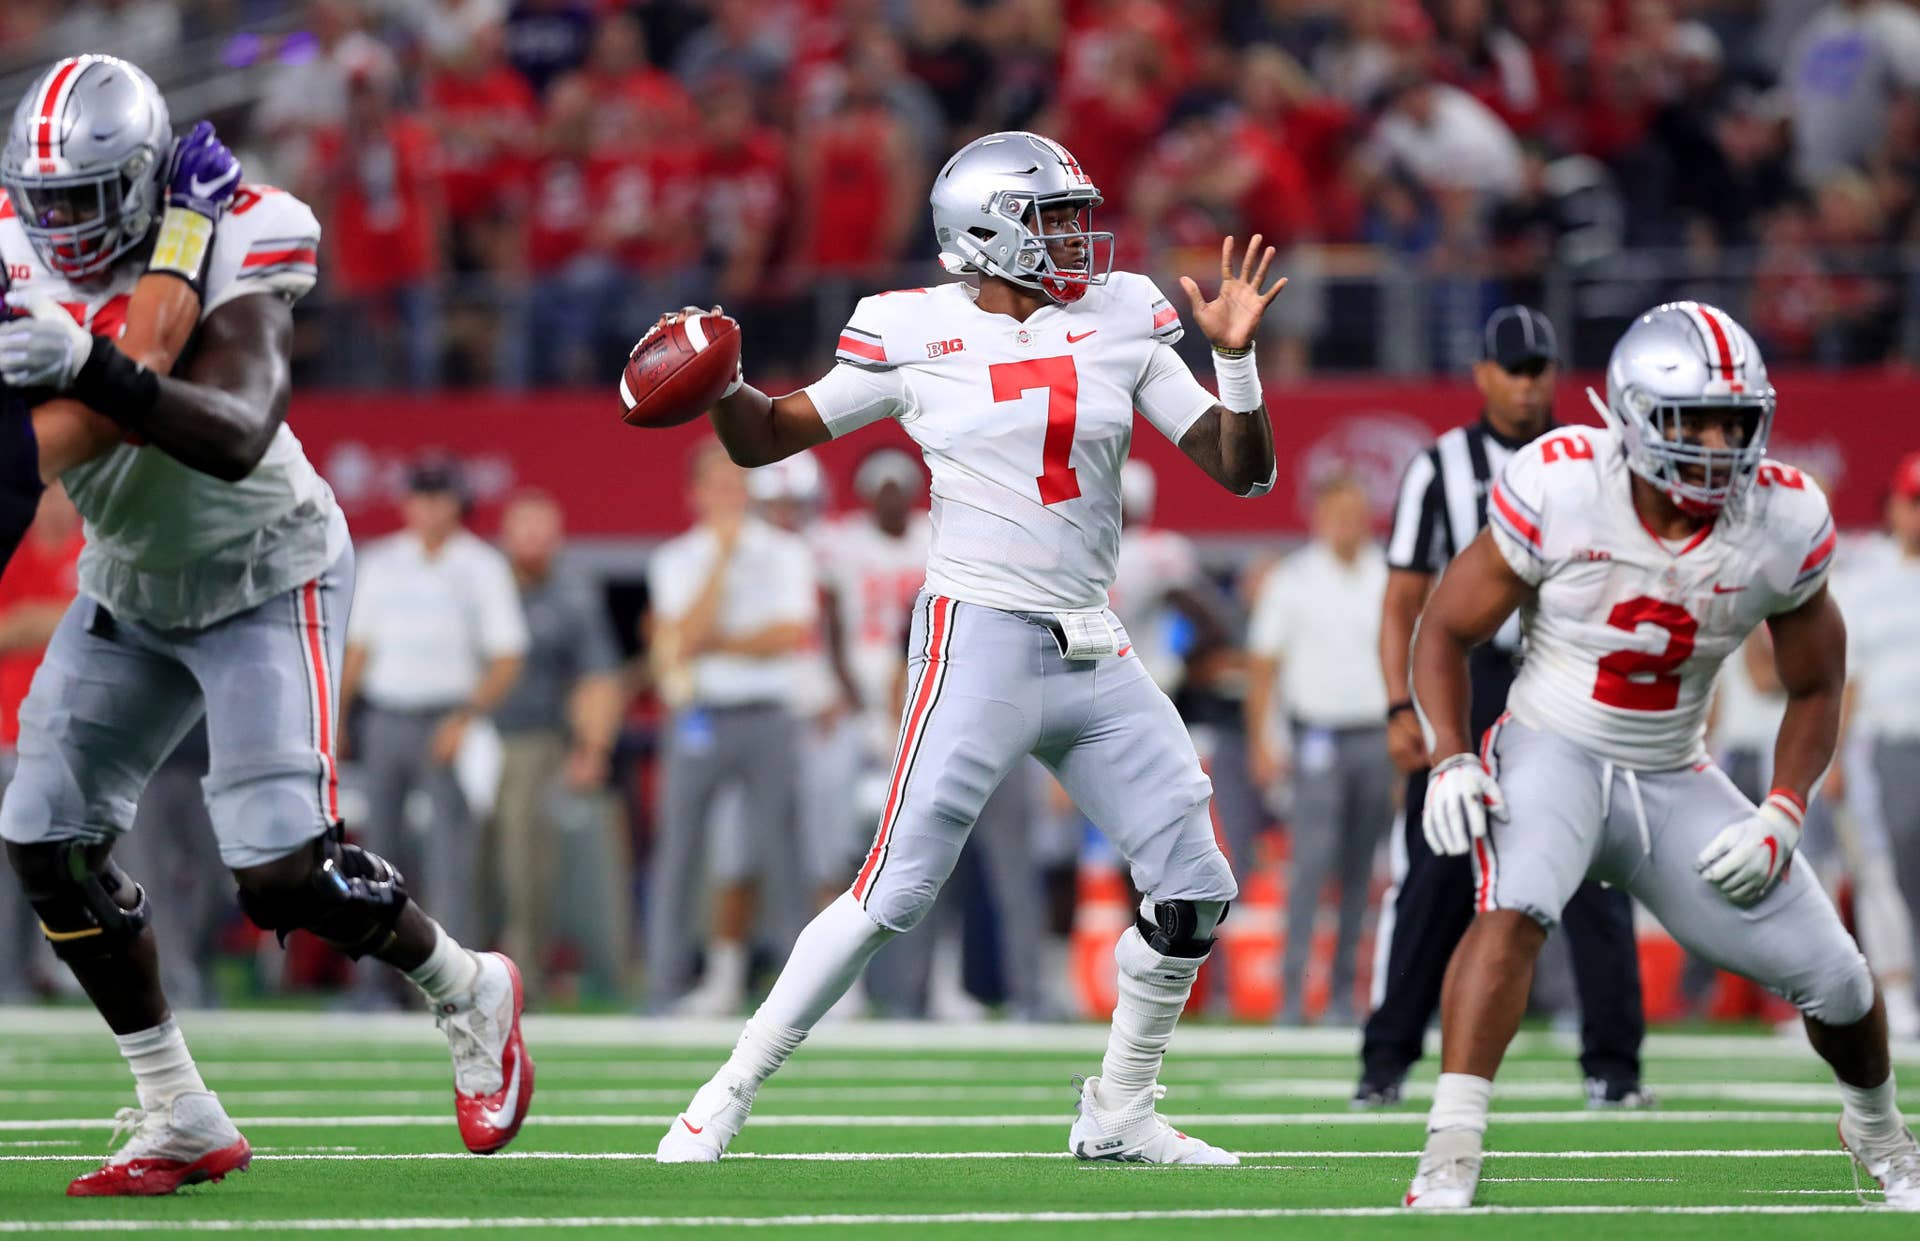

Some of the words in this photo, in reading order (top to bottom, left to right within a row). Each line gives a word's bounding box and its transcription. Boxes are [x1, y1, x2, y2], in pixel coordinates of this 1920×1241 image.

[988, 354, 1082, 506] 7
[1540, 434, 1594, 464] 2
[1756, 465, 1805, 491] 2
[1592, 595, 1699, 712] 2
